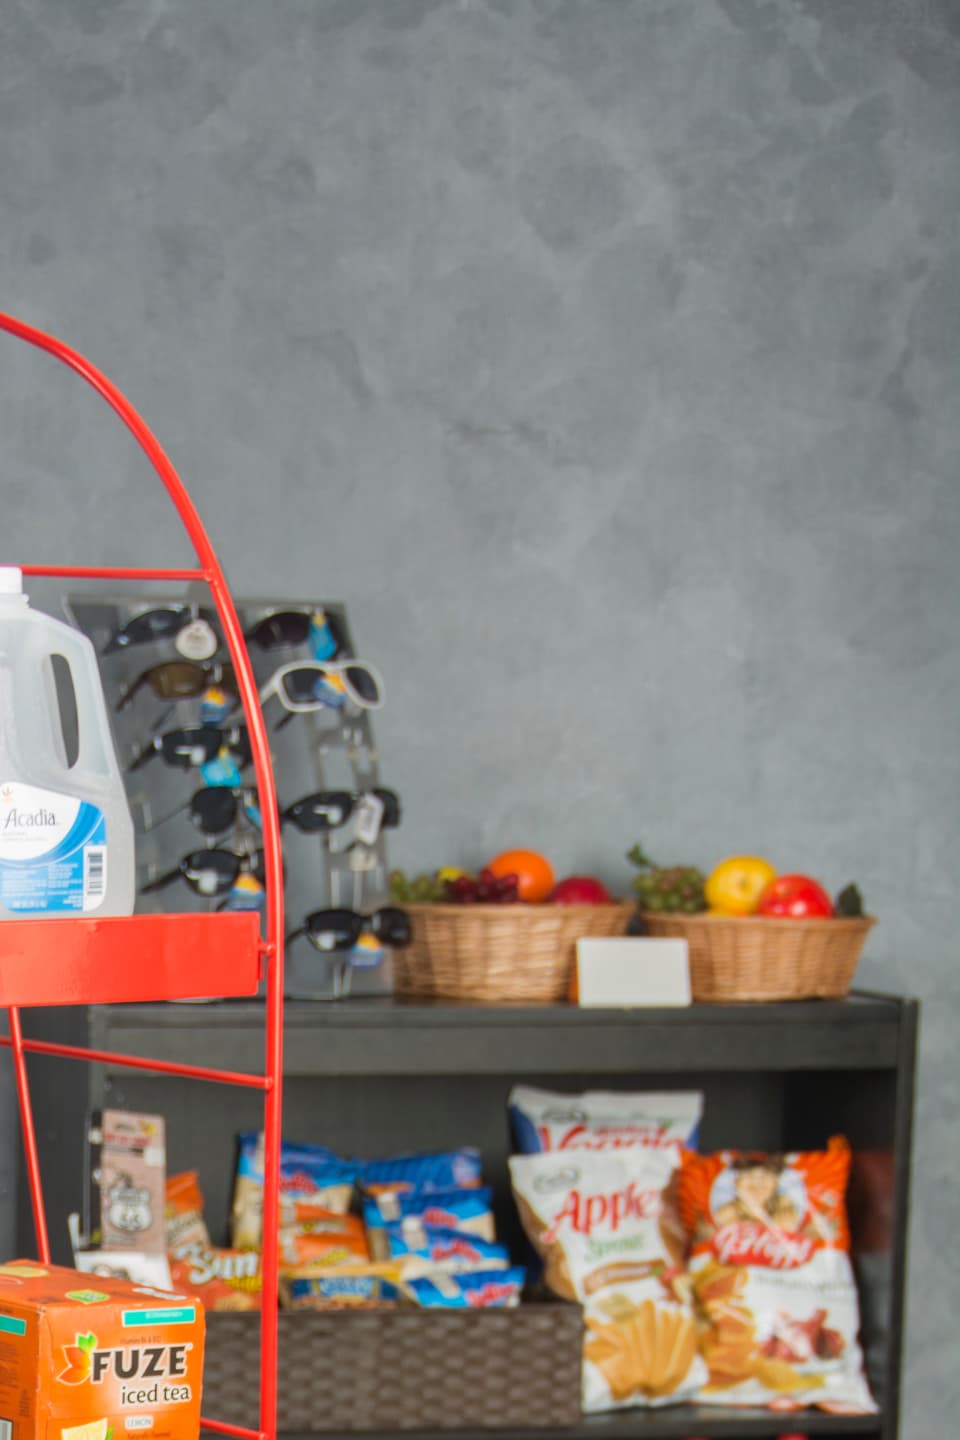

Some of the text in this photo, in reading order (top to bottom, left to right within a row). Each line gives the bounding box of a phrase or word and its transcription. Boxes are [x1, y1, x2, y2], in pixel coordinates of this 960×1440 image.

[3, 808, 56, 829] Acadia
[92, 1345, 187, 1383] FUZE
[121, 1382, 191, 1406] iced tea
